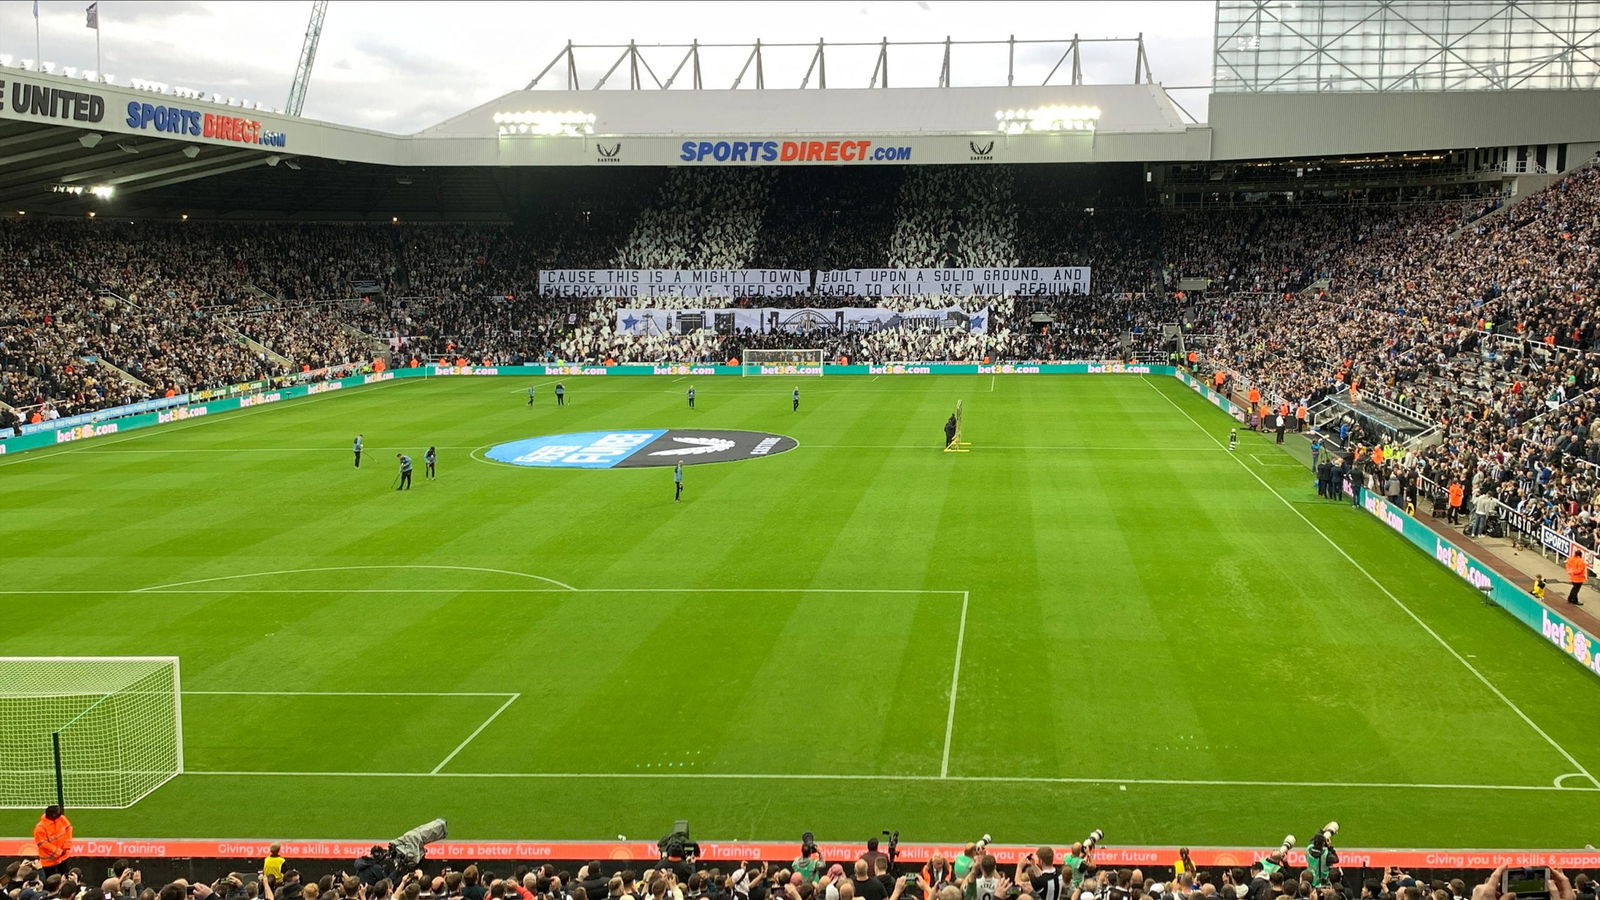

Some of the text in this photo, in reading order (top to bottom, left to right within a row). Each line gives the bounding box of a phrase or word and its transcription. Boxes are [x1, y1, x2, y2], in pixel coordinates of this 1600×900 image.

[12, 82, 104, 123] UNITED
[608, 270, 640, 283] THIS
[650, 270, 663, 283] IS
[674, 270, 682, 282] A
[692, 270, 749, 282] MIGHTY
[760, 270, 802, 282] TOWN
[822, 271, 861, 283] BUILT
[871, 270, 906, 282] UPON
[916, 270, 924, 282] A
[934, 270, 974, 282] SOLID
[1054, 269, 1082, 280] AND
[865, 284, 882, 296] TO
[1544, 532, 1569, 554] SPORTS
[88, 842, 112, 856] Day
[116, 842, 166, 856] Training
[218, 844, 254, 856] Giving
[280, 844, 300, 854] the
[302, 844, 330, 855] skills
[333, 845, 341, 855] &
[448, 845, 464, 855] for
[467, 847, 475, 855] a
[477, 845, 512, 855] better
[516, 845, 551, 855] future
[710, 844, 761, 857] Training
[902, 848, 929, 858] skills
[994, 852, 1014, 861] you
[1121, 851, 1158, 861] future
[1426, 854, 1464, 866] Giving
[1468, 857, 1489, 866] you
[1493, 854, 1512, 865] the
[1516, 854, 1545, 865] skills
[1549, 856, 1556, 865] &
